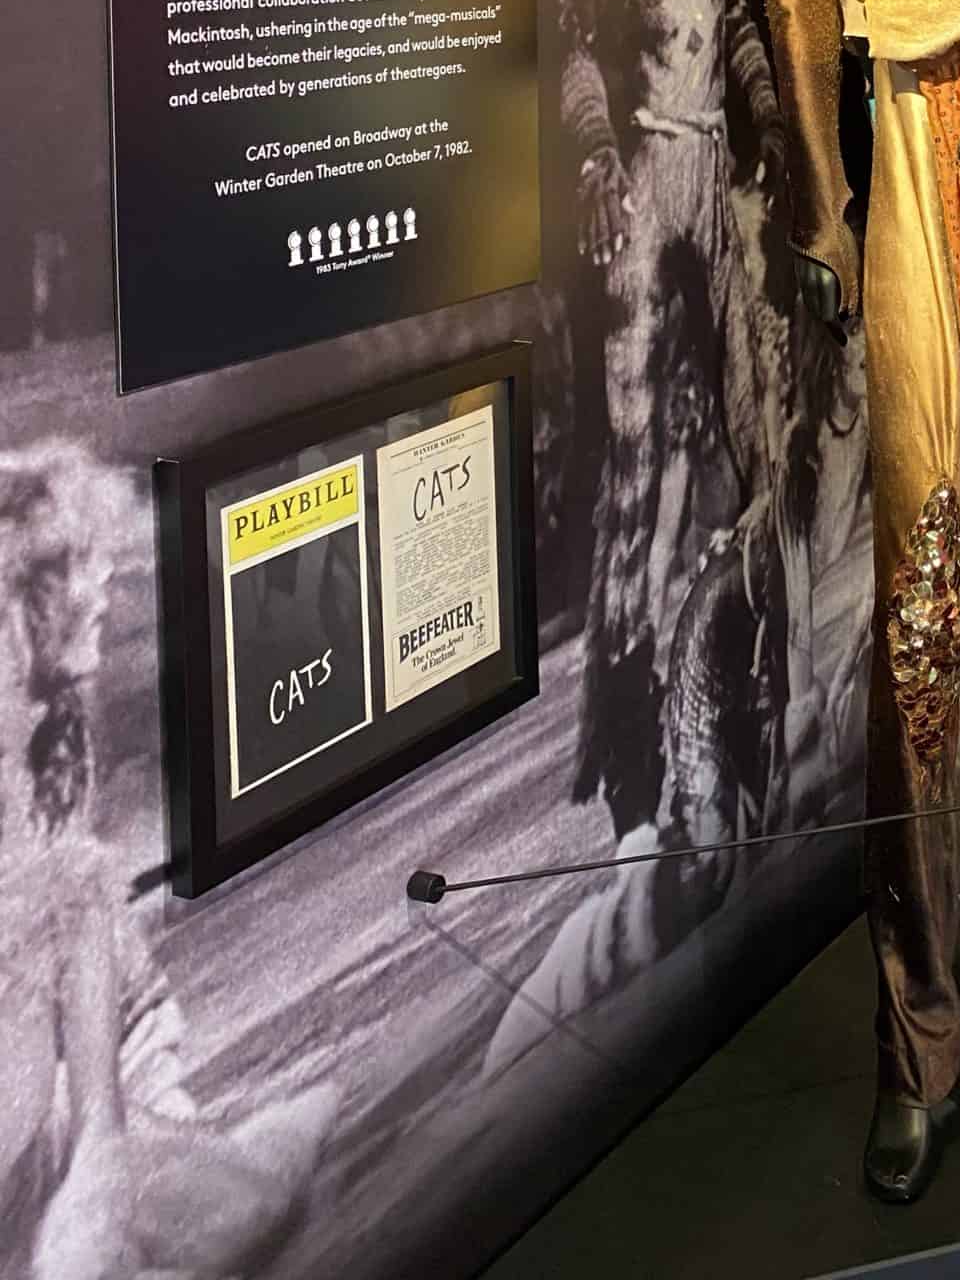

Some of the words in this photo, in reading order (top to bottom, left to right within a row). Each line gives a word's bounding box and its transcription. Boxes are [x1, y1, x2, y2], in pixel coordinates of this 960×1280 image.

[168, 87, 198, 107] and
[201, 79, 276, 104] celebrated
[279, 79, 296, 98] by
[297, 71, 373, 97] generations
[375, 67, 388, 83] of
[390, 63, 466, 81] theatregoers.
[214, 178, 263, 197] Winter
[264, 168, 314, 188] Garden
[315, 161, 365, 179] Theatre
[366, 158, 383, 171] on
[384, 148, 432, 167] October
[433, 144, 443, 161] 7,
[445, 140, 473, 157] 1982.
[245, 142, 281, 162] CATS
[283, 134, 331, 159] opened
[334, 136, 351, 148] on
[353, 126, 412, 145] Broadway
[414, 123, 427, 136] at
[429, 118, 449, 133] the
[234, 473, 354, 540] PLAYBILL
[413, 455, 471, 522] CATS
[399, 601, 474, 664] BEEFEATER
[412, 654, 425, 669] The
[426, 642, 446, 659] Crown
[447, 632, 464, 649] Jewel
[269, 648, 332, 725] CATS
[421, 663, 428, 672] of
